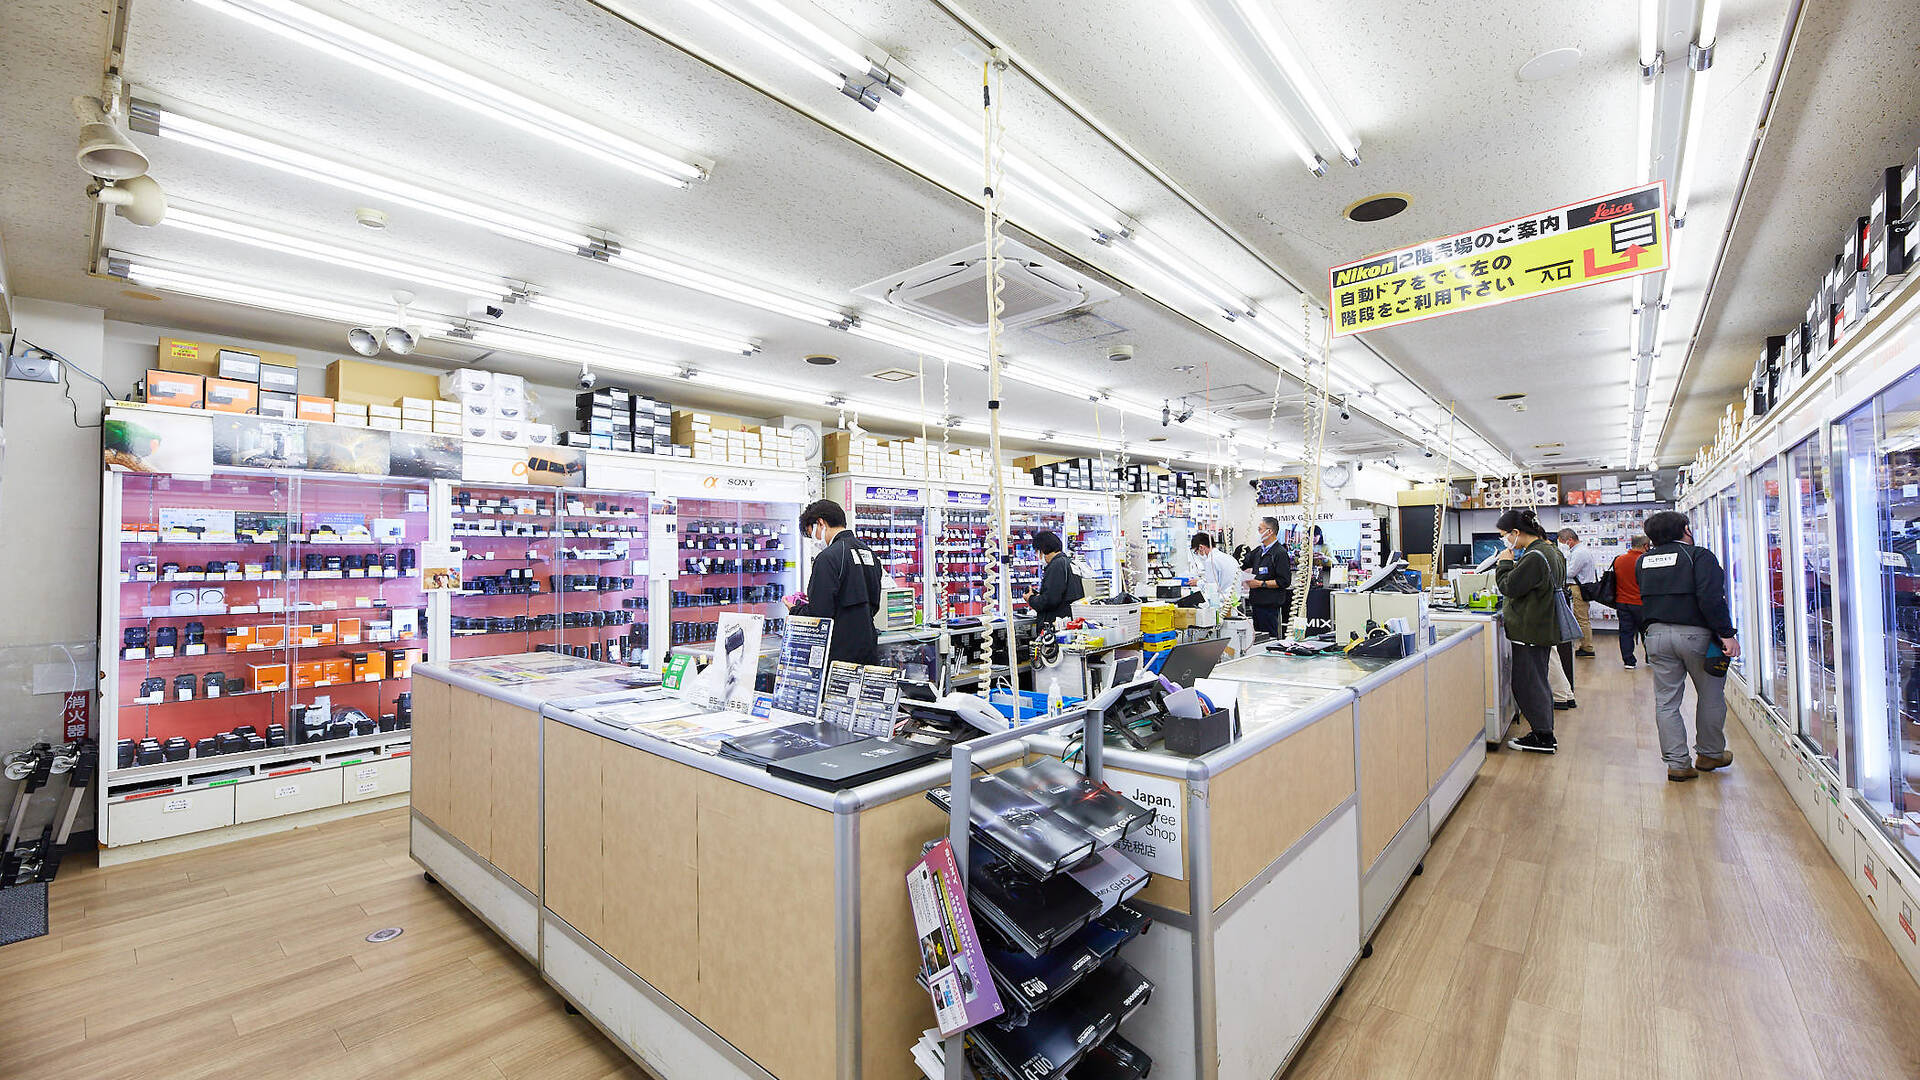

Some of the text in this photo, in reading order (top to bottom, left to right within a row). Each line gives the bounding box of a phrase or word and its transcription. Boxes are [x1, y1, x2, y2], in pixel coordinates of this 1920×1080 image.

[1588, 201, 1636, 222] Leica
[1399, 215, 1560, 270] 2階売場のご案内
[1336, 261, 1395, 287] Nikon
[1341, 255, 1512, 307] 自動ドアをでて左の
[1540, 265, 1572, 284] 入口
[1341, 276, 1515, 327] 階段をご利用下さい
[727, 478, 755, 487] SONY
[1275, 514, 1296, 522] UMIX
[1306, 618, 1332, 629] MIX
[67, 694, 87, 738] 消火器
[1132, 788, 1176, 809] Japan.
[1155, 813, 1177, 826] ree
[1145, 823, 1177, 843] Shop
[944, 847, 959, 886] SONY
[1022, 978, 1049, 998] OM-D
[1122, 981, 1150, 1007] Panasonic
[1023, 1056, 1056, 1080] OM-D
